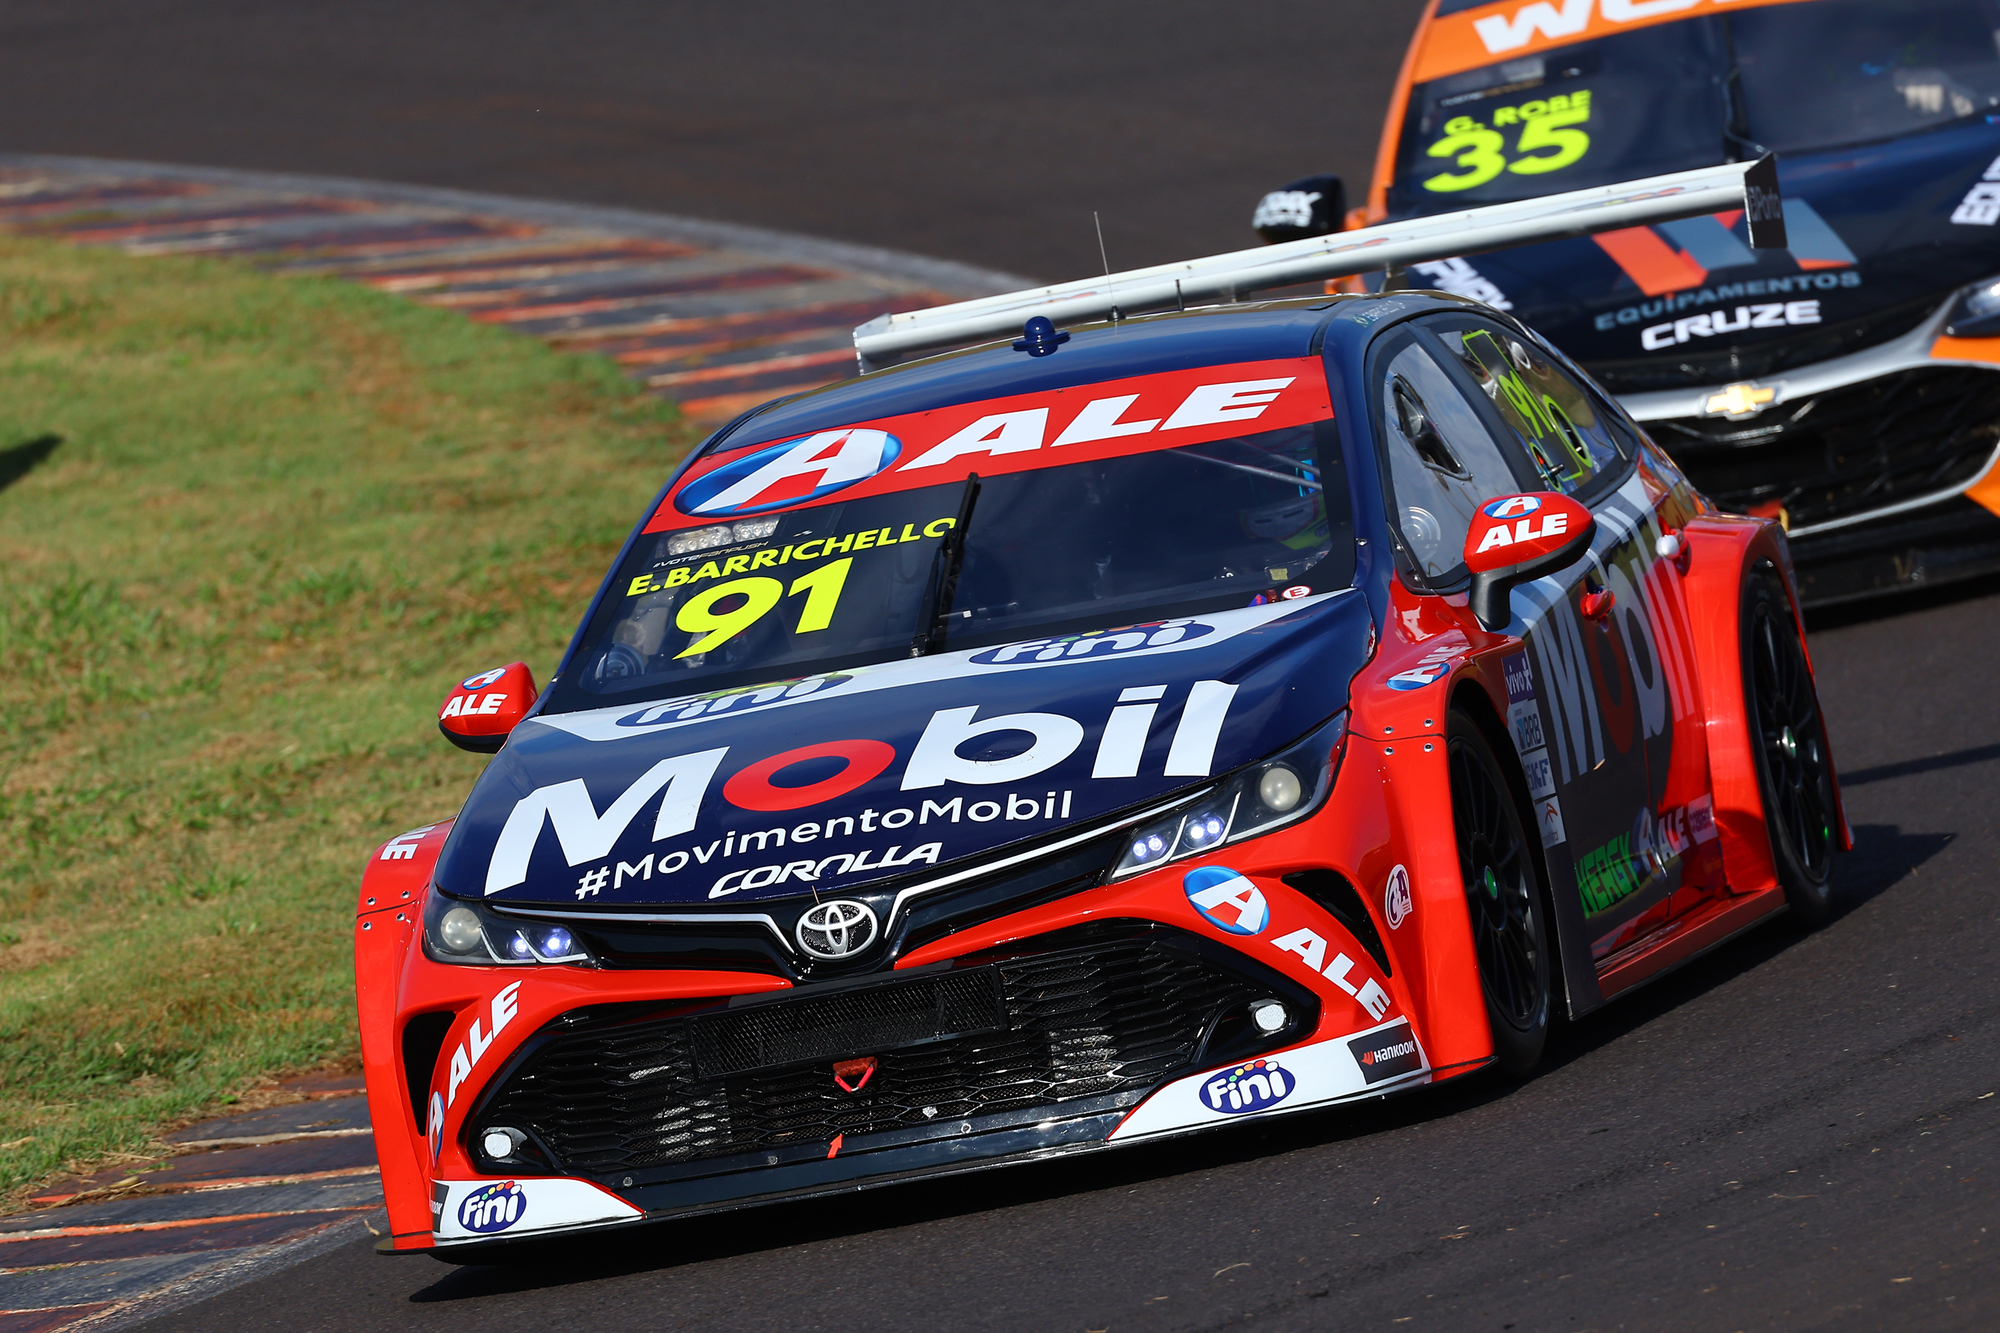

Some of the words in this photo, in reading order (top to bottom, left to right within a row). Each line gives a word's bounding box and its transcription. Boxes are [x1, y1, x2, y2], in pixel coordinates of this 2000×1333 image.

[1493, 89, 1592, 127] ROBE
[1423, 105, 1590, 192] 35
[1594, 271, 1861, 331] EQUIPAMENTOS
[1641, 299, 1822, 351] CRUZE
[895, 377, 1296, 472] ALE
[626, 518, 957, 597] E.BARRICHELLO
[1476, 513, 1568, 553] ALE
[672, 557, 853, 660] 91
[991, 620, 1194, 662] Fini
[636, 673, 836, 724] Fini
[1506, 664, 1525, 695] vivo
[440, 693, 508, 720] ALE
[1523, 713, 1542, 747] BRB
[484, 680, 1239, 897] Mobil
[1526, 758, 1549, 791] SKF
[575, 790, 1072, 900] #MovimentoMobil
[708, 842, 943, 899] COROLLA
[1270, 927, 1391, 1022] ALE
[447, 980, 522, 1109] ALE
[1207, 1061, 1287, 1110] Fini
[462, 1185, 522, 1229] Fini
